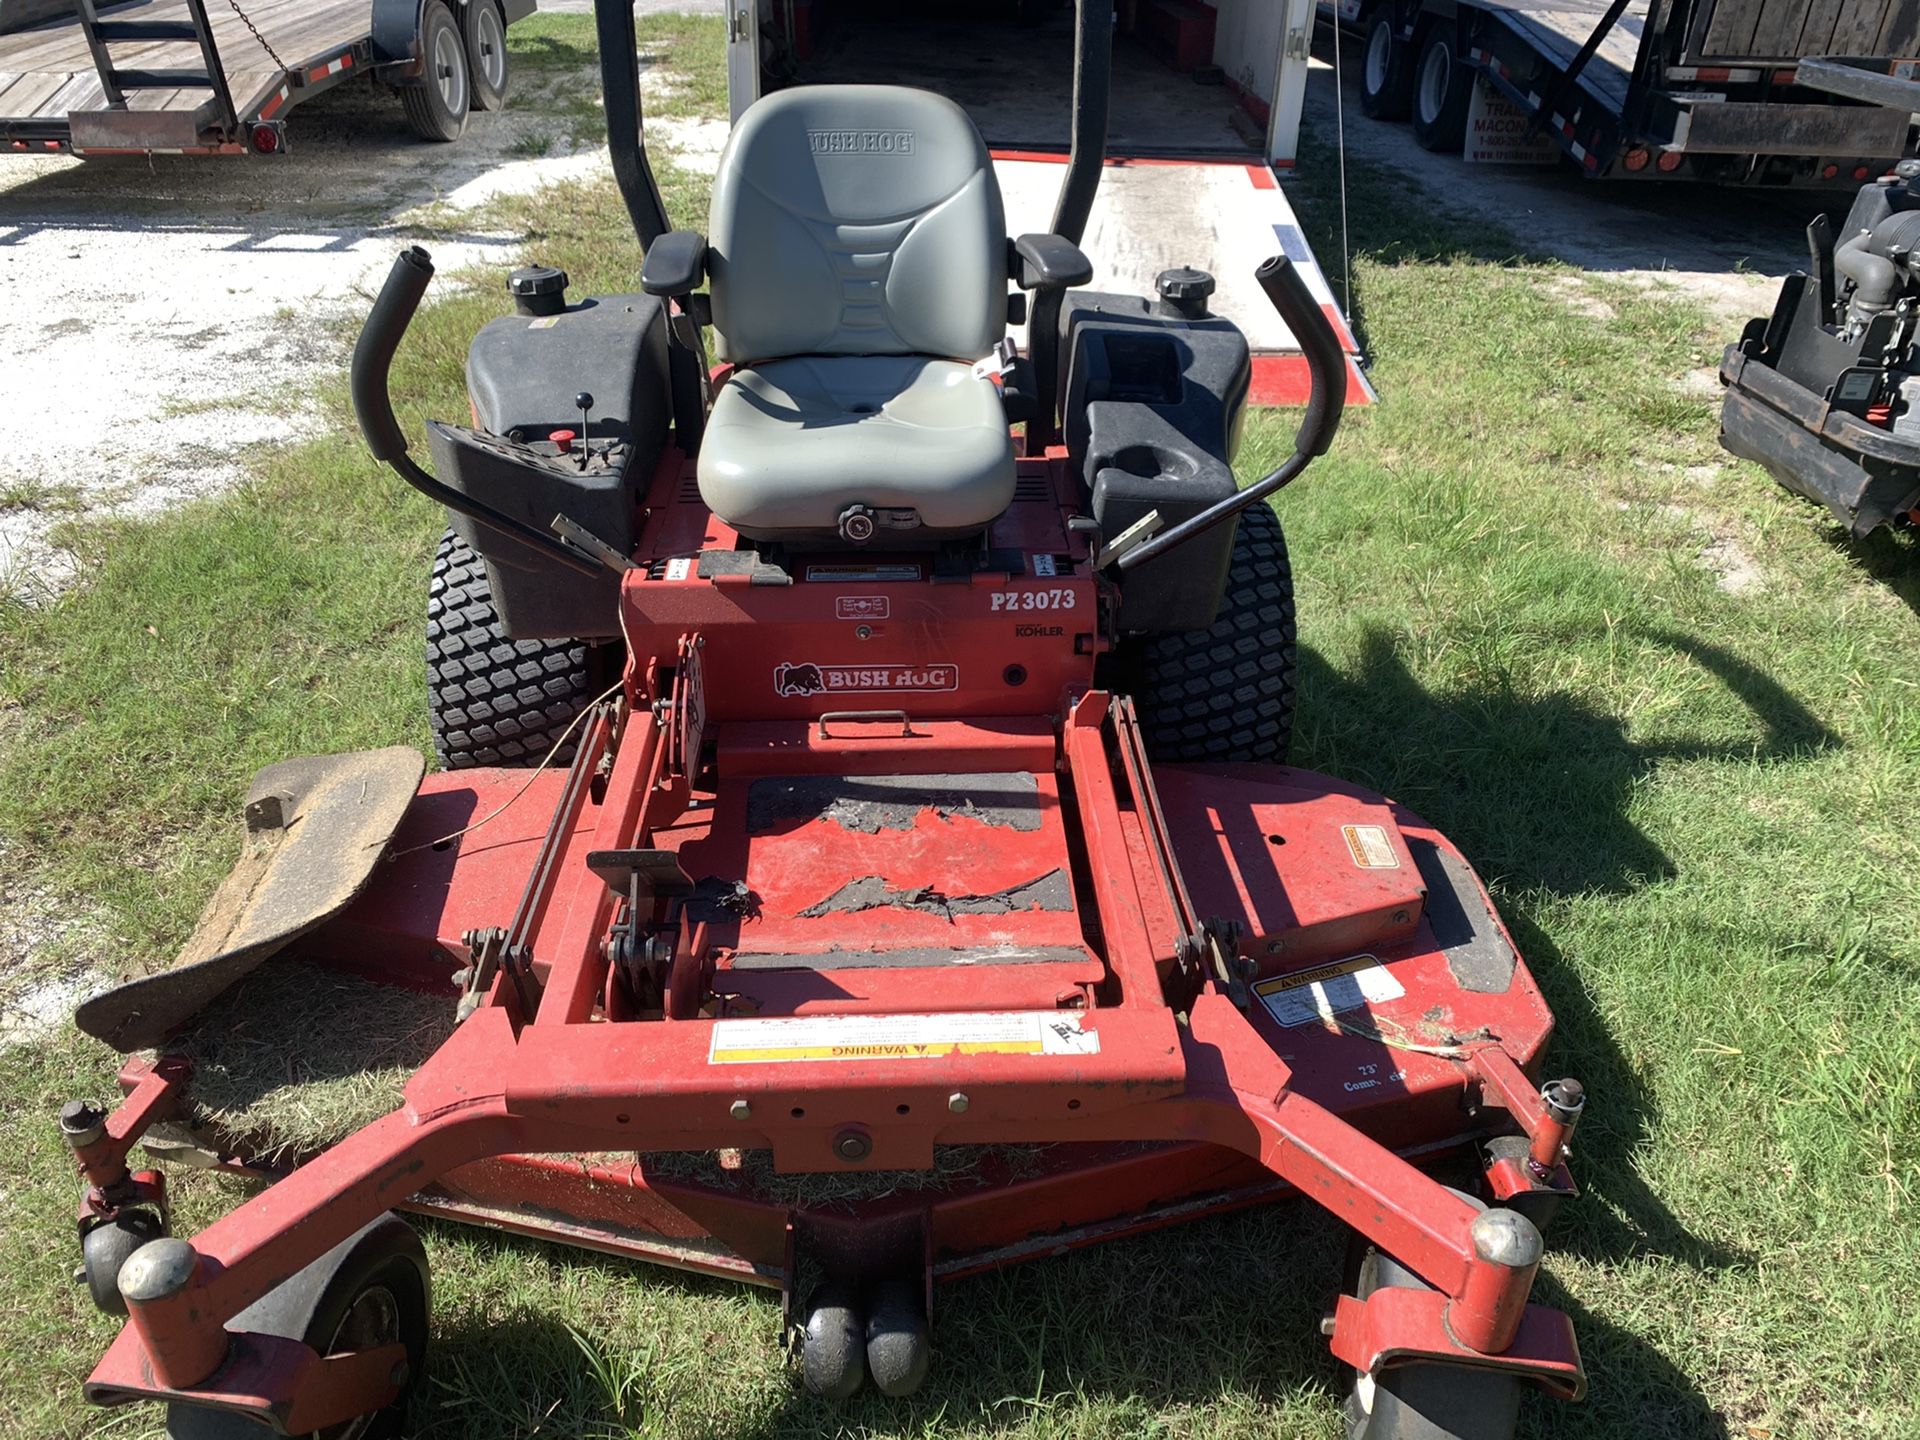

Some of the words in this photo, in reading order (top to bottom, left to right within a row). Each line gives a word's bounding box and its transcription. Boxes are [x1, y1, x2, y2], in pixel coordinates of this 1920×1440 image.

[862, 132, 913, 153] HOG
[991, 592, 1019, 611] PZ
[1022, 589, 1076, 610] 3073
[1015, 626, 1063, 637] KOHLER
[828, 671, 890, 687] BUSH
[895, 670, 946, 686] HOG
[1291, 966, 1343, 986] WARNING
[831, 1045, 909, 1056] WARNING
